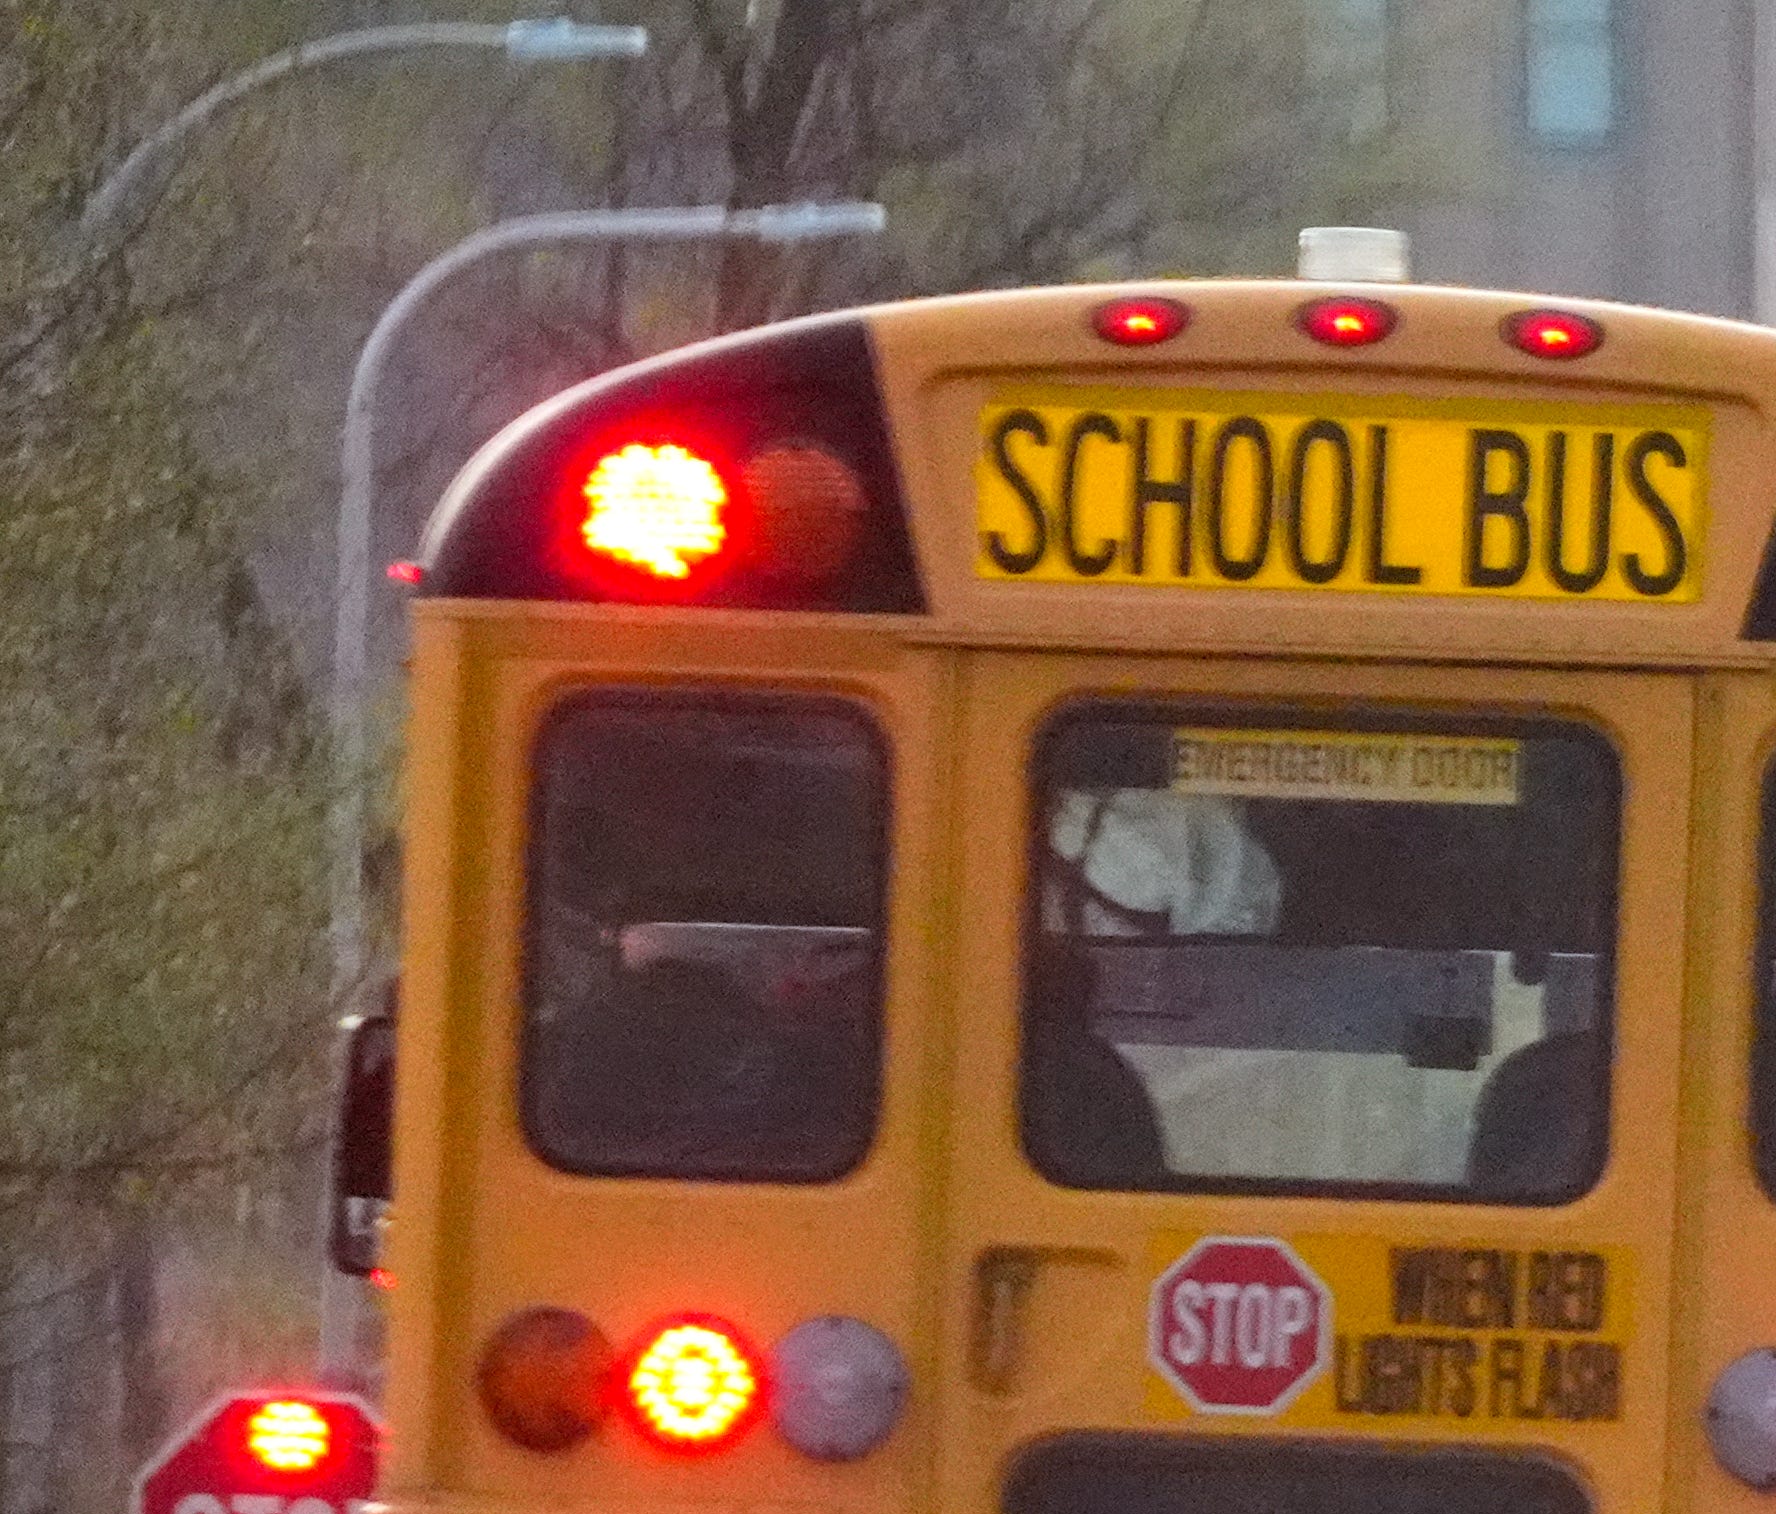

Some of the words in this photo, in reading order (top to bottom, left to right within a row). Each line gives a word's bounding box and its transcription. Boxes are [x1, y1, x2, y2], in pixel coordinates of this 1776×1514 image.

[986, 407, 1422, 585] SCHOOL
[1466, 428, 1688, 595] BUS
[1175, 738, 1401, 786] EMERGENCY
[1411, 746, 1513, 790] DOOR
[1168, 1278, 1313, 1369] STOP
[1389, 1246, 1515, 1327] WHEN
[1529, 1250, 1607, 1331] RED
[1335, 1333, 1478, 1417] LIGHTS
[1489, 1337, 1622, 1421] FLASH
